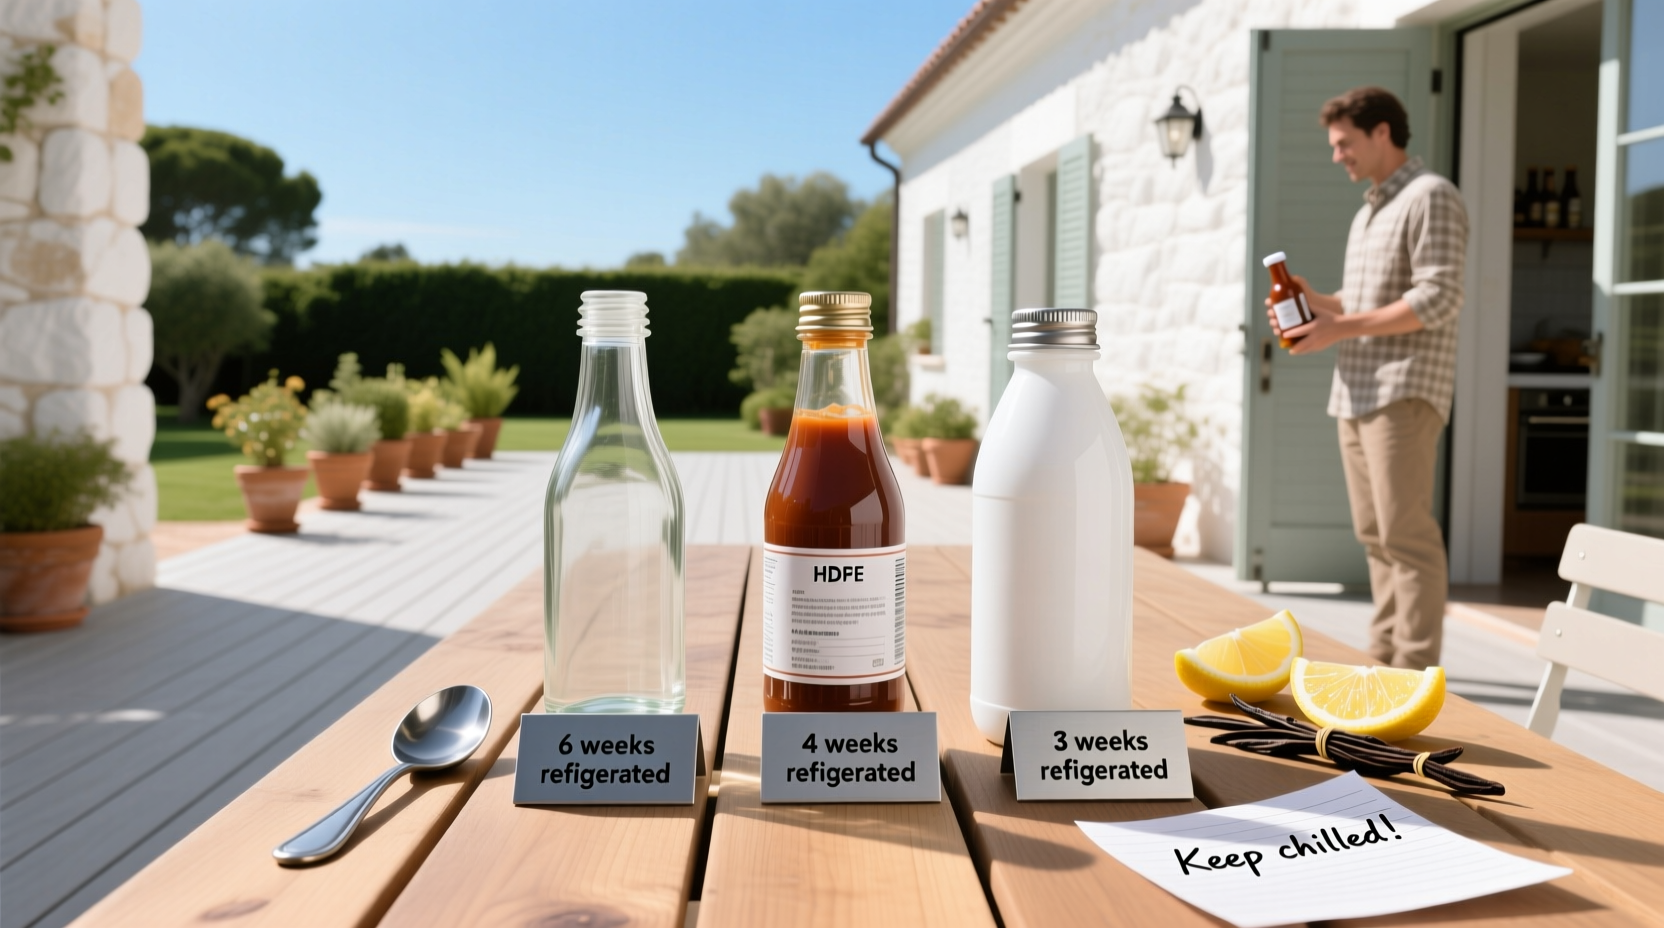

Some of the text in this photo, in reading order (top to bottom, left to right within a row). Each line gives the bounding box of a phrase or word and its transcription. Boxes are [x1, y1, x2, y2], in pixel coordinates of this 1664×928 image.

[558, 734, 655, 755] 6 weeks
[802, 732, 899, 754] 4 weeks
[1053, 729, 1149, 751] 3 weeks
[540, 762, 671, 789] refigerated
[786, 761, 916, 787] refigerated
[1041, 758, 1168, 786] refigerated
[1174, 813, 1402, 877] Keep chilled!
